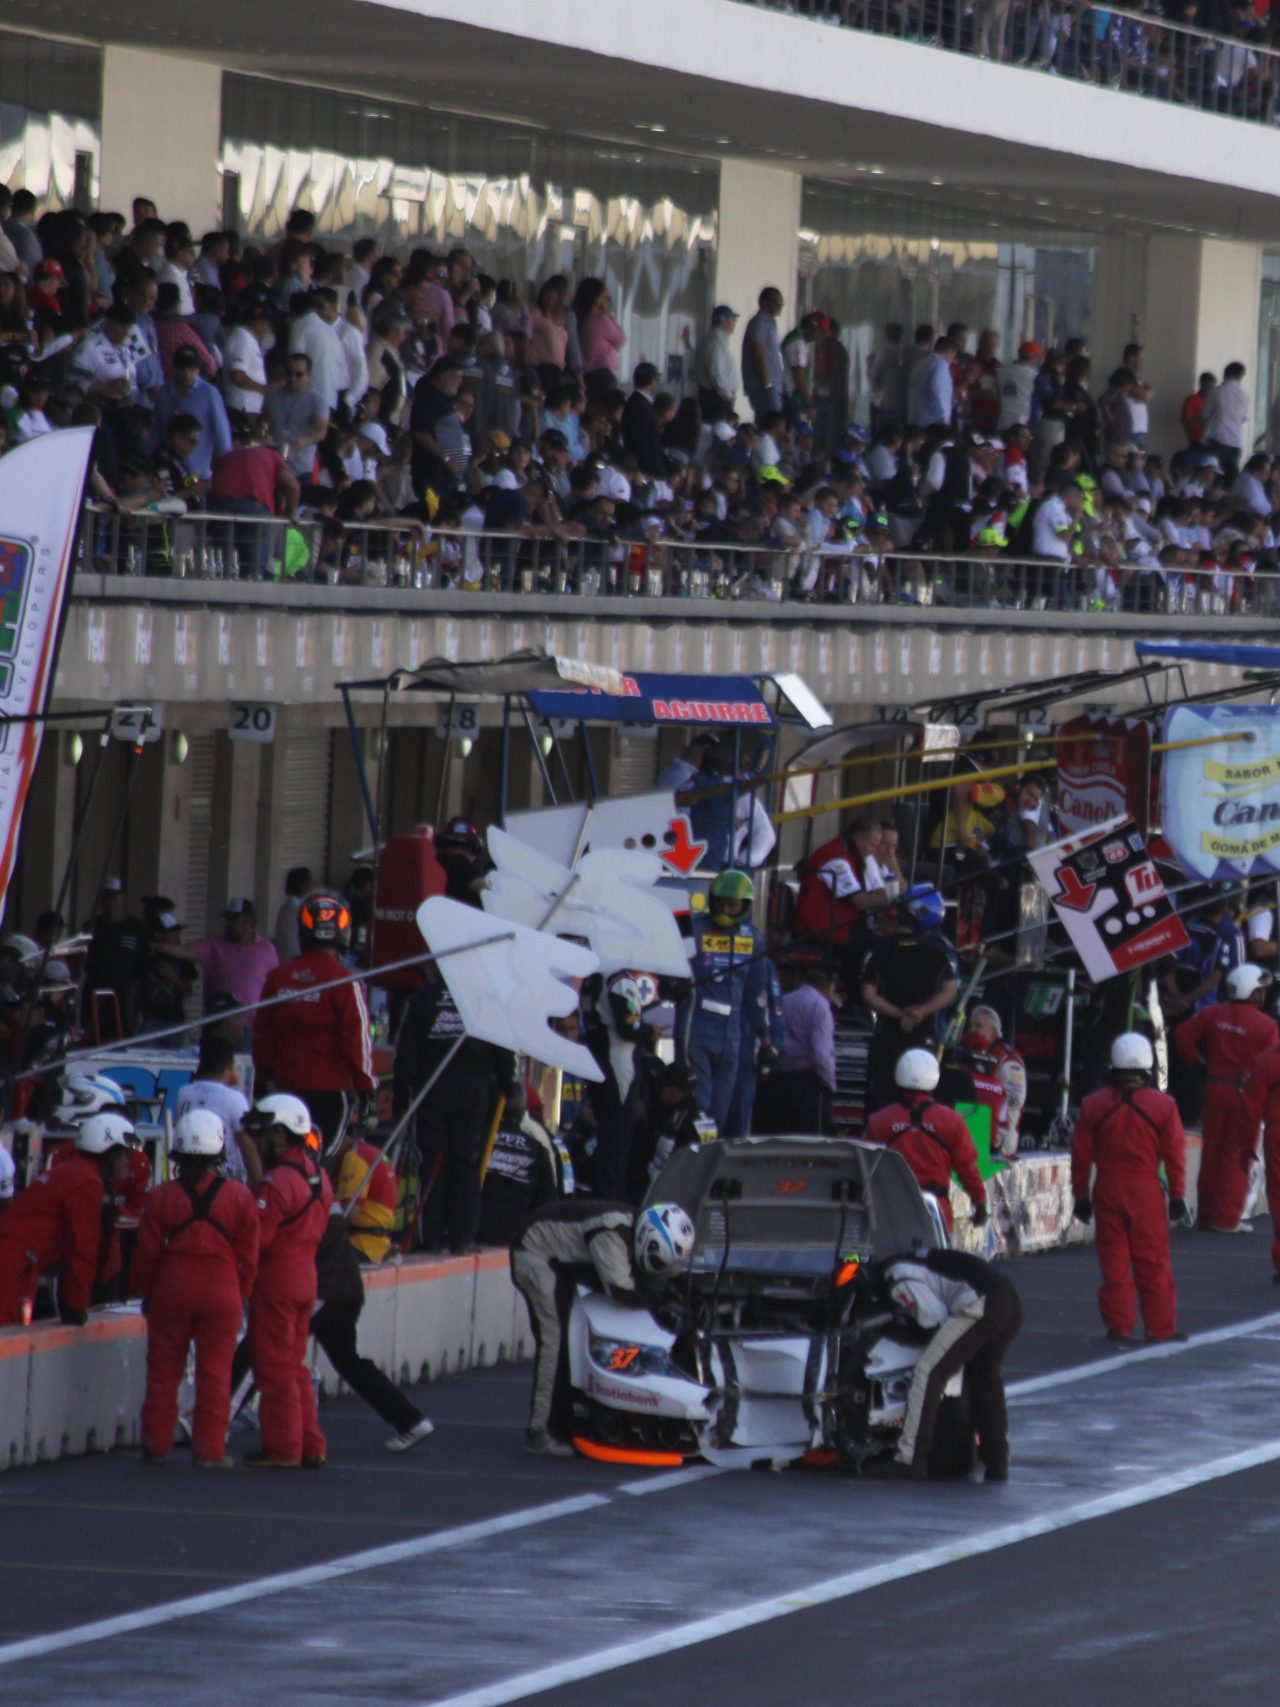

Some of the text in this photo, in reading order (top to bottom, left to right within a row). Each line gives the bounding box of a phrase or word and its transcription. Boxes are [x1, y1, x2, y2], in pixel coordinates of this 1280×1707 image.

[233, 707, 272, 732] 20
[652, 700, 772, 724] AGUIRRE
[1224, 765, 1272, 780] SABOR
[1210, 840, 1250, 855] GOMA
[1251, 839, 1269, 851] DE
[606, 1346, 640, 1370] 37
